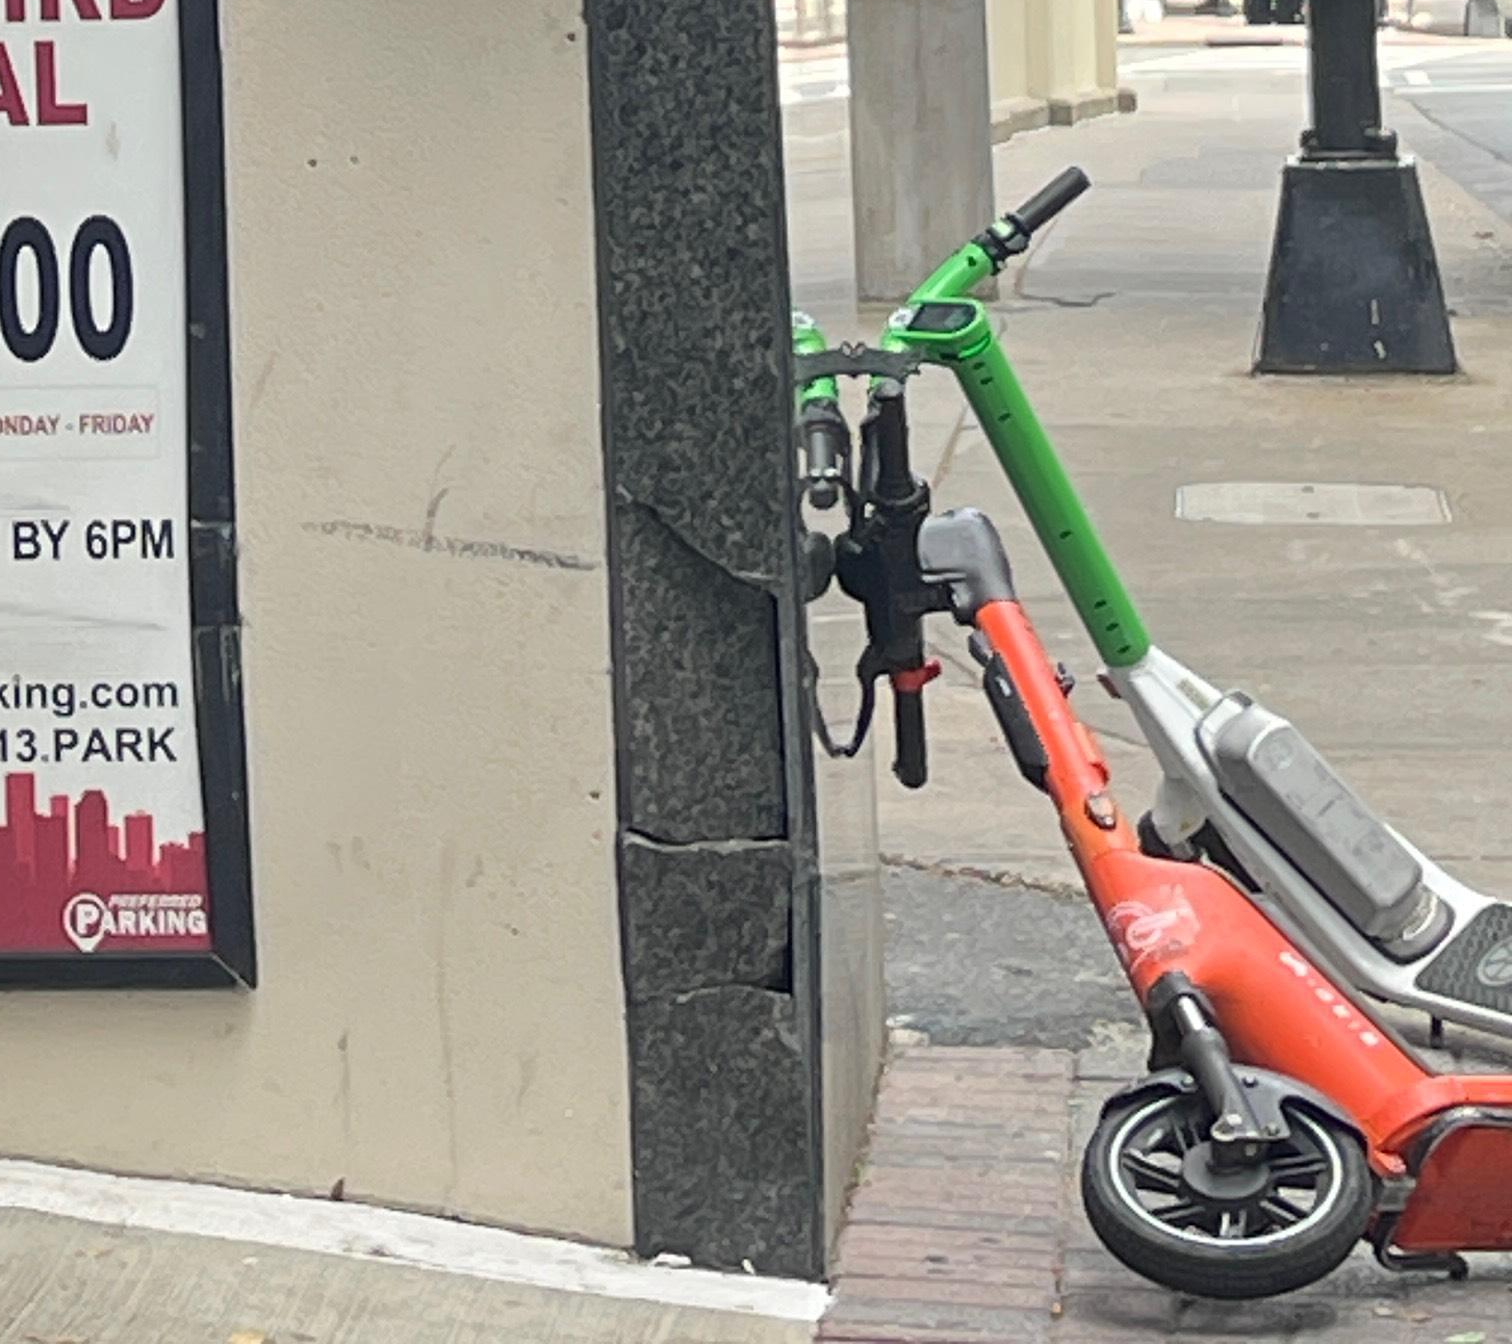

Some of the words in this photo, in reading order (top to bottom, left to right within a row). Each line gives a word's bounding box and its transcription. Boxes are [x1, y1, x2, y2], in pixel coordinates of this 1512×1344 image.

[79, 412, 154, 434] FRIDAY
[12, 520, 71, 561] BY
[86, 519, 175, 560] 6PM
[77, 903, 208, 935] PARKING
